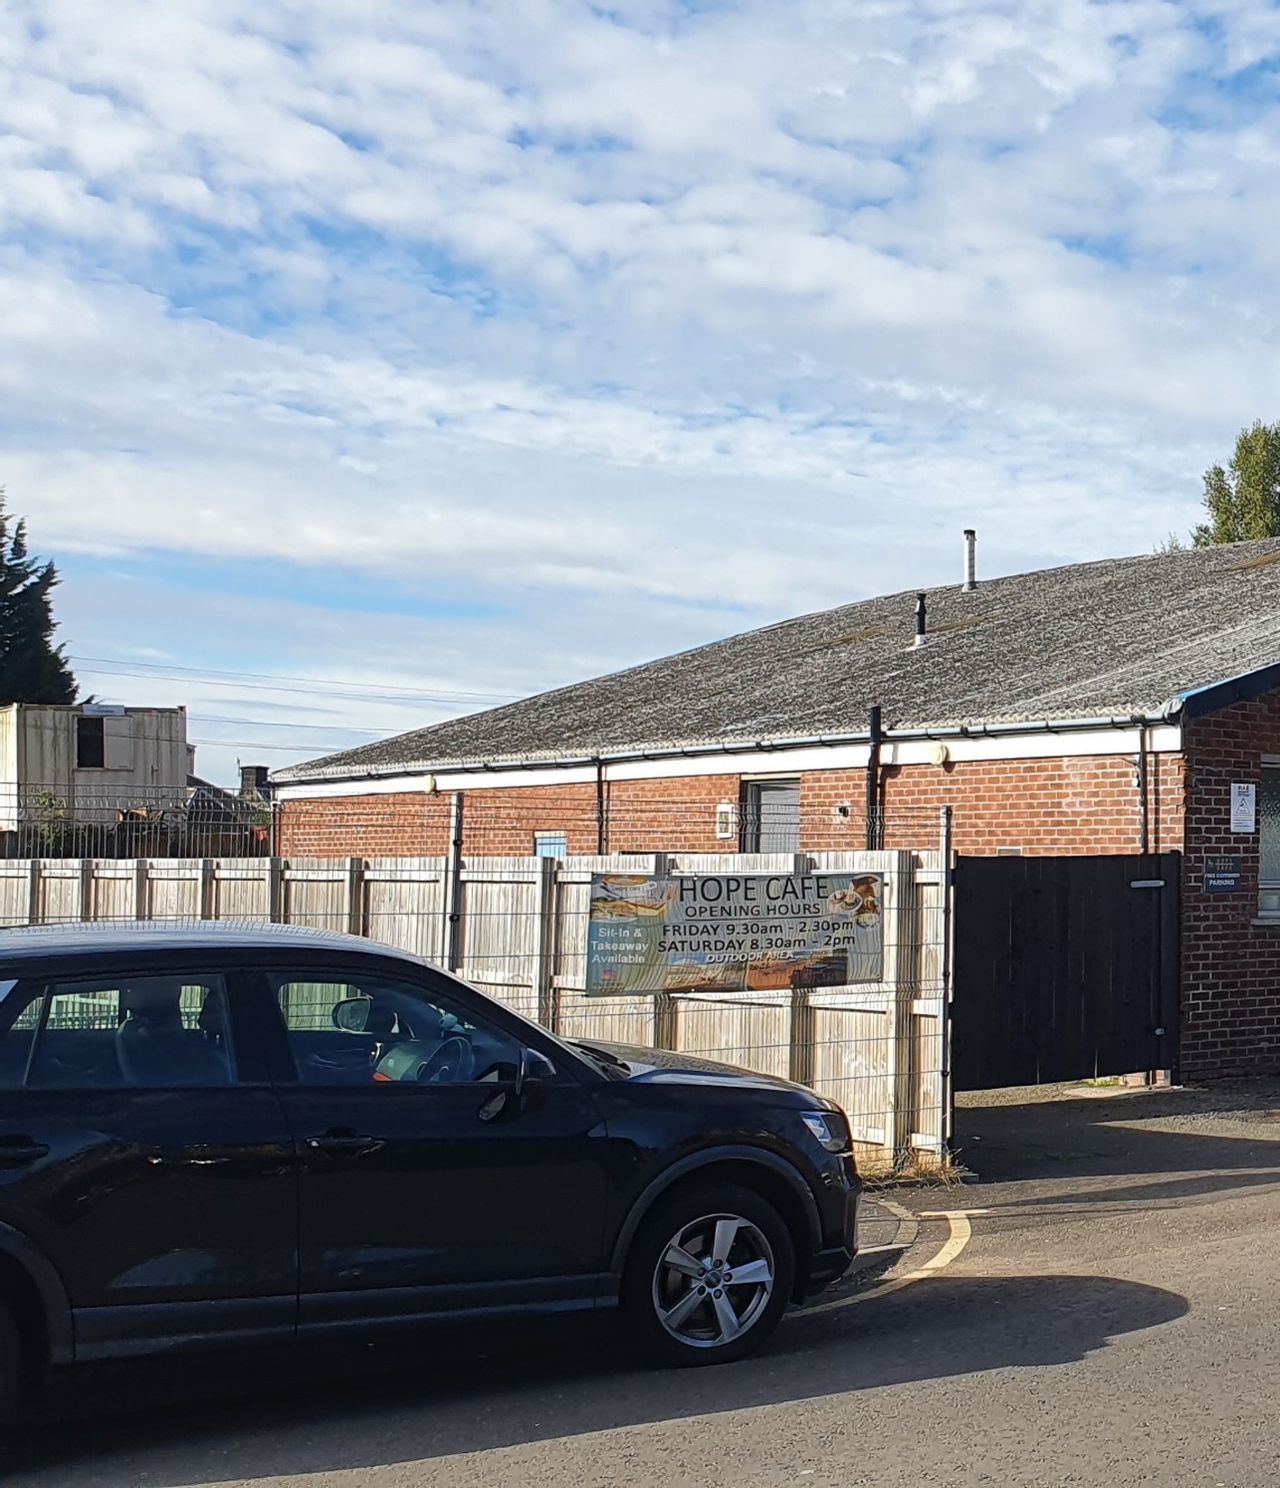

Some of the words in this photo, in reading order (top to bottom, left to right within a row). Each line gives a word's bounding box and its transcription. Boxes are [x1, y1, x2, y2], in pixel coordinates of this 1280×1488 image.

[679, 877, 756, 902] HOPE
[765, 876, 829, 901] CAFE
[685, 904, 761, 918] OPENING
[766, 902, 821, 916] HOURS
[598, 927, 631, 938] Sit-In
[633, 928, 643, 938] &
[662, 924, 721, 937] FRIDAY
[726, 923, 783, 936] 9.30am
[799, 920, 854, 934] 2.30pm
[590, 941, 649, 953] Takeaway
[657, 939, 746, 953] SATURDAY
[750, 937, 807, 950] 8.30am
[823, 934, 856, 948] 2pm
[591, 953, 646, 964] Available
[706, 951, 764, 965] OUTDOOR
[765, 950, 796, 961] AREA
